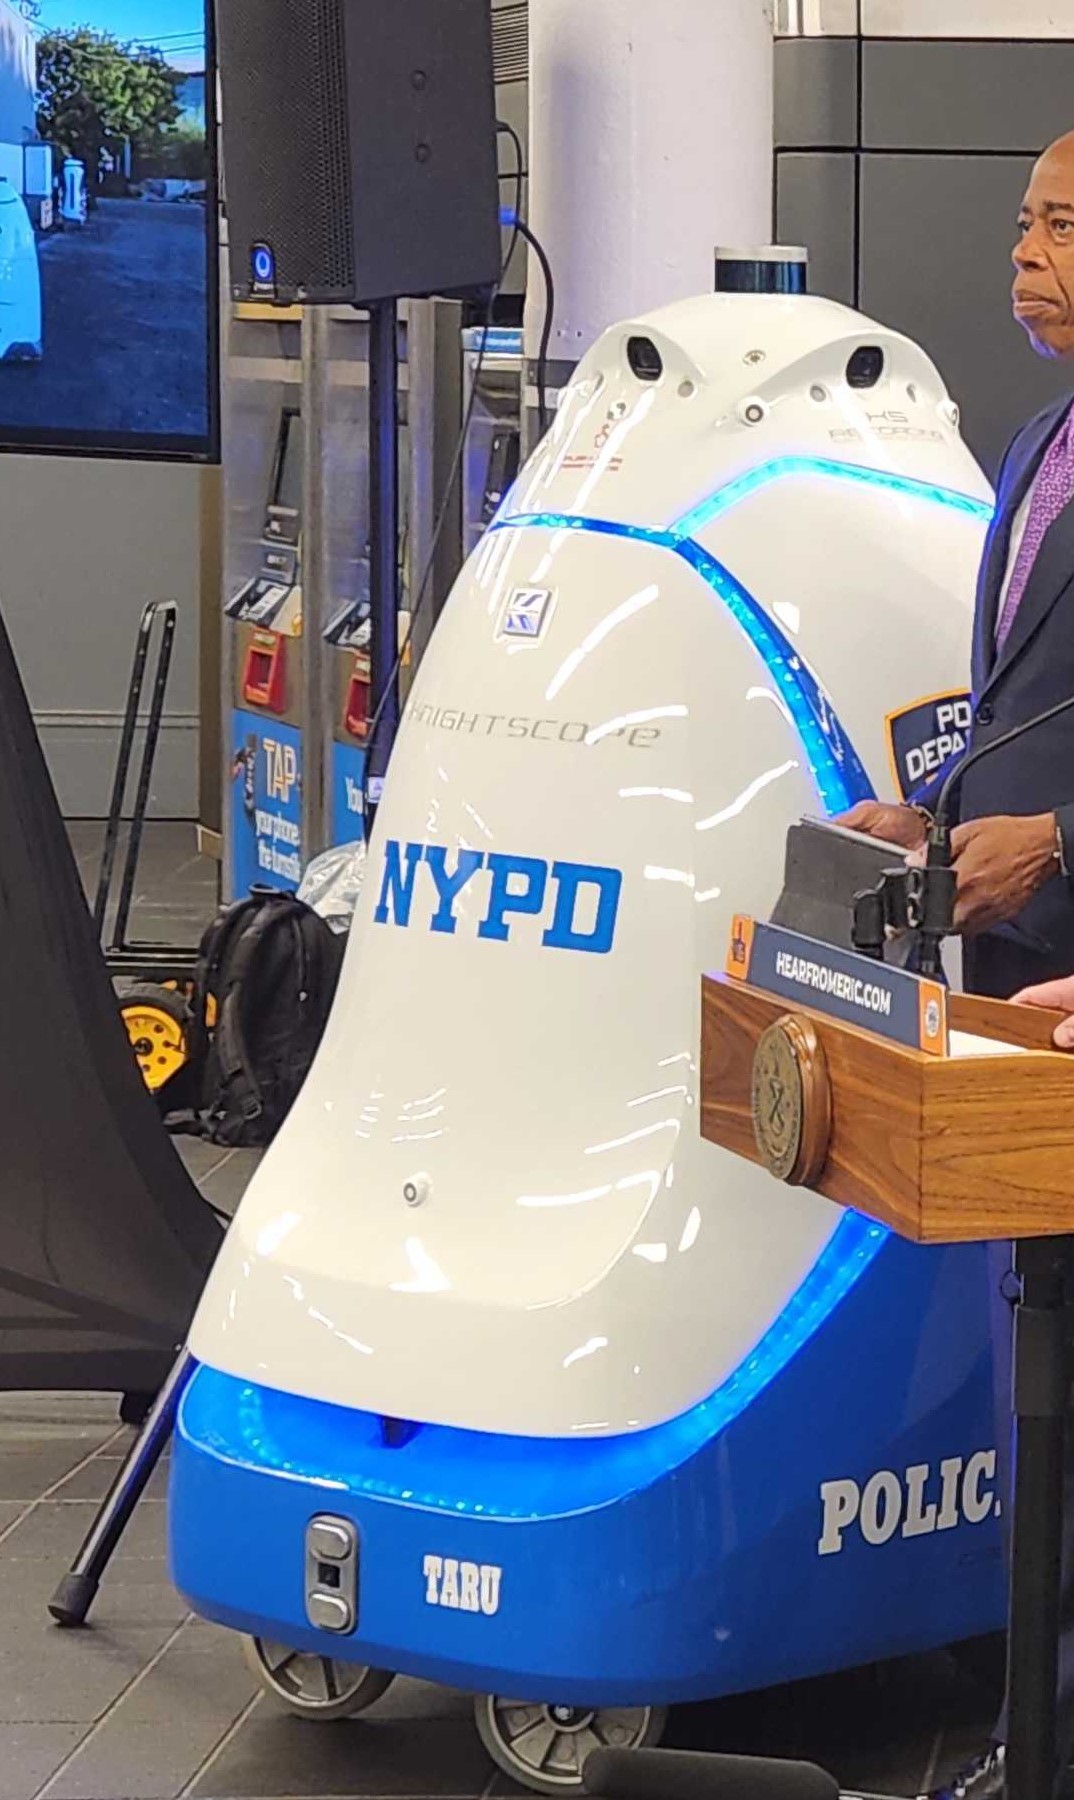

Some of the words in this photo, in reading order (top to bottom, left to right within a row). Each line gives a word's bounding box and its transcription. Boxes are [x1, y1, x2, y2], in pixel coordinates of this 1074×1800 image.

[936, 700, 971, 733] PO
[263, 737, 297, 803] TAP
[905, 730, 969, 782] DEPA
[373, 839, 623, 954] NYPD
[776, 951, 892, 1016] HEARFROMERIC.COM
[818, 1449, 1000, 1555] POLIC
[423, 1554, 503, 1615] TARU
